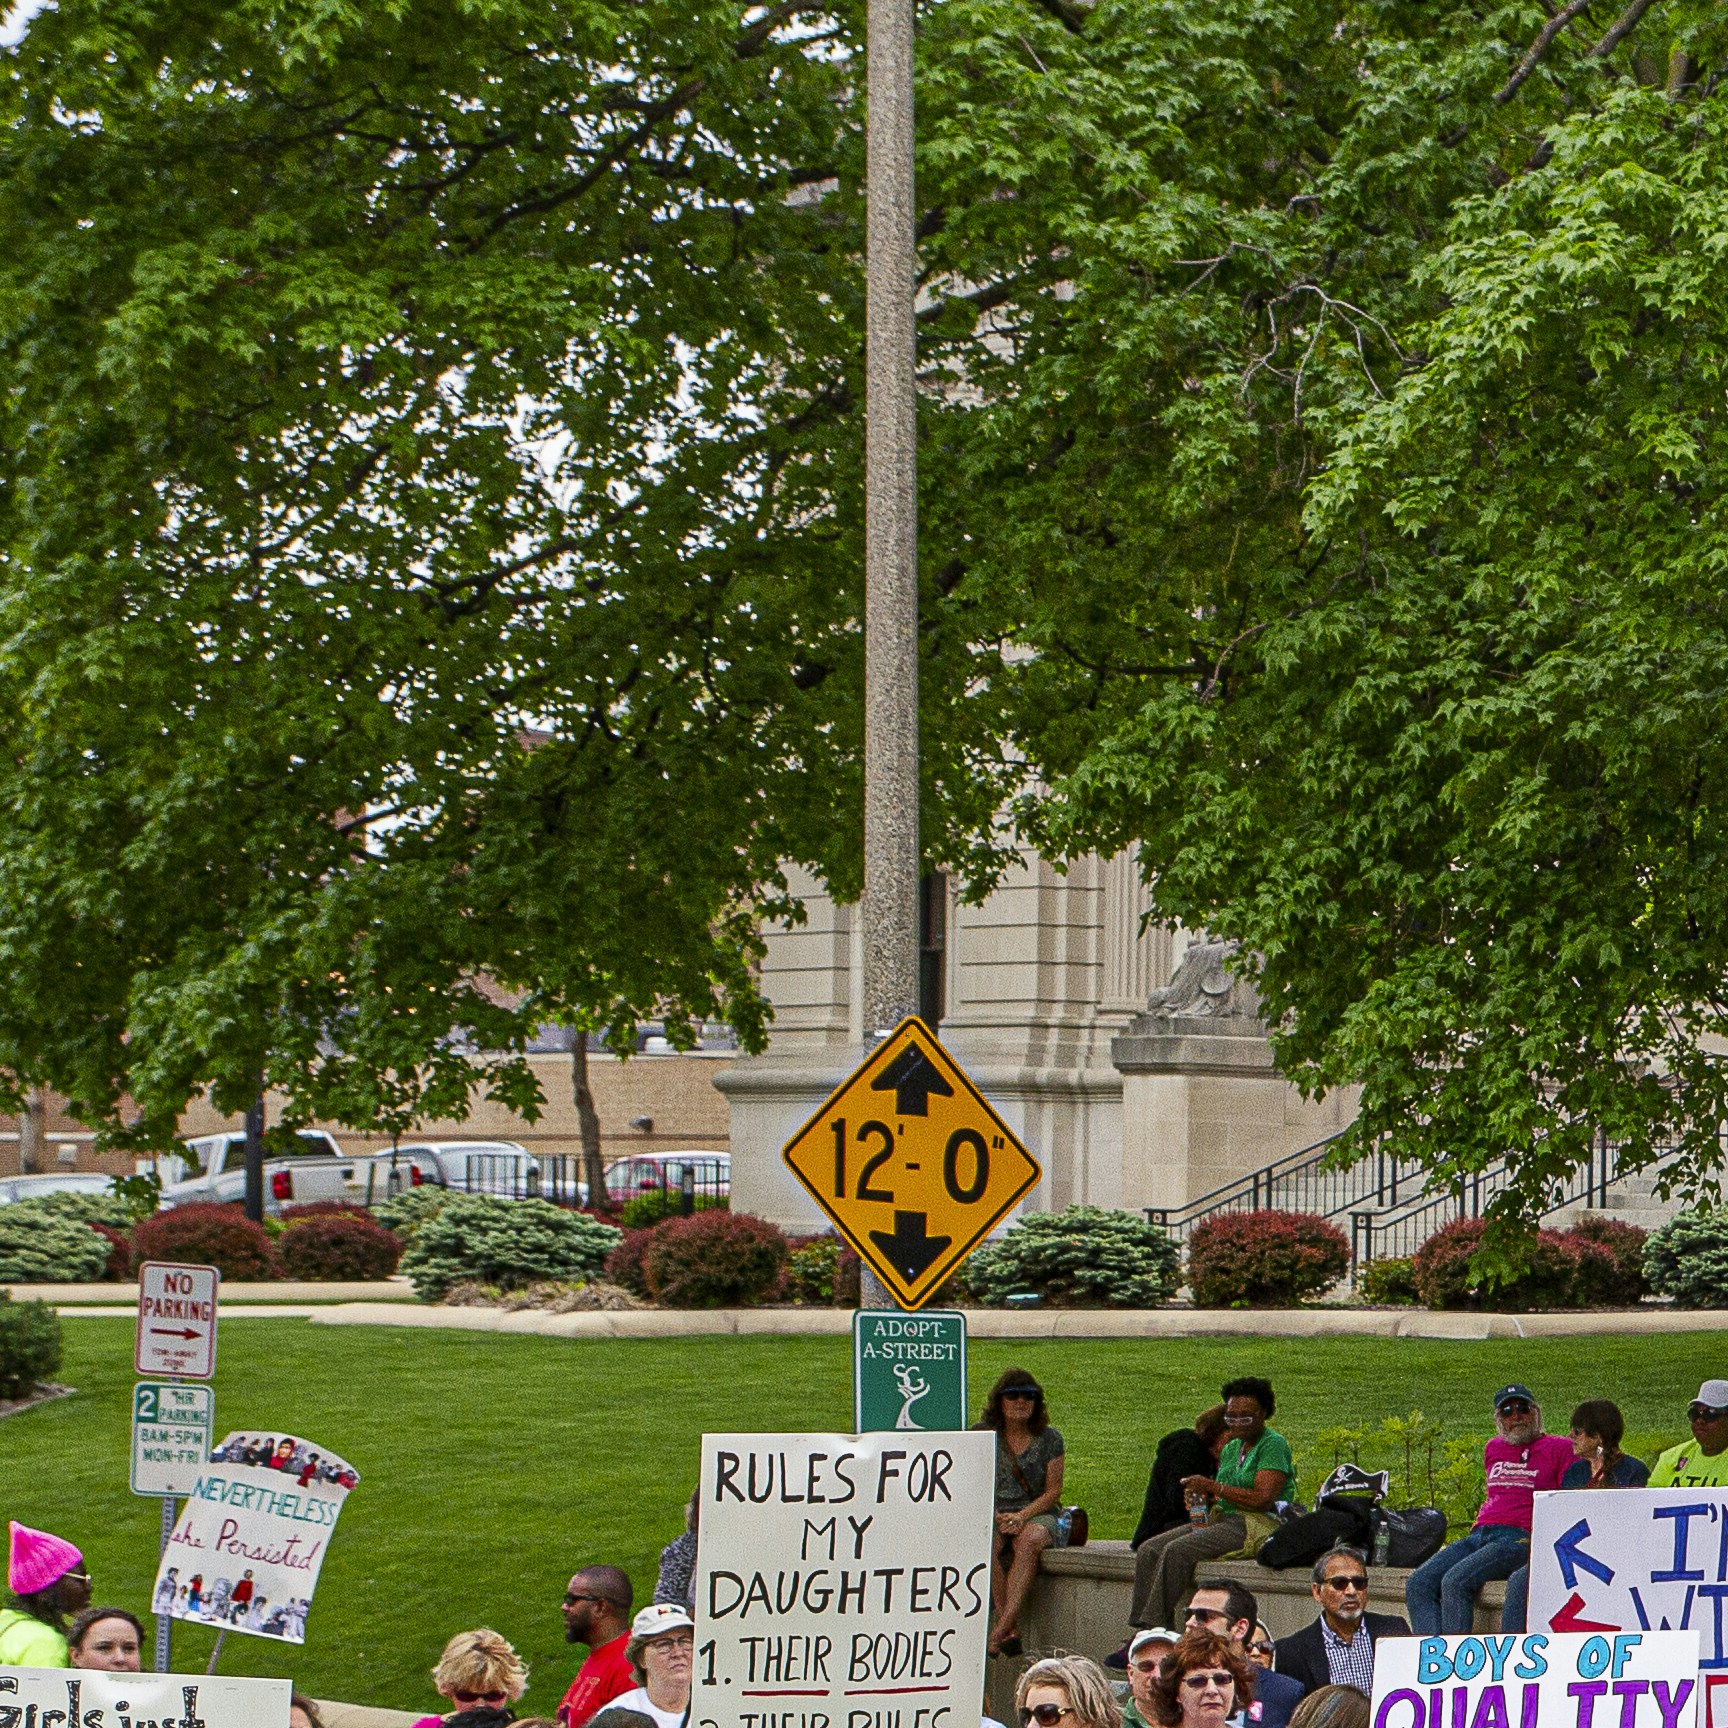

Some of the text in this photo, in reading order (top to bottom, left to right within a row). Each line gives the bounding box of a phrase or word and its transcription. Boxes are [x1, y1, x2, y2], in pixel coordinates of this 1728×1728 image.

[163, 1273, 194, 1295] NO
[143, 1297, 212, 1322] PARKING
[873, 1320, 947, 1338] ADOPT-
[863, 1342, 958, 1361] A-STREET
[138, 1390, 196, 1418] 2 HR
[159, 1407, 208, 1424] PARKING
[140, 1428, 203, 1445] 8AM-5PM
[143, 1450, 198, 1465] MON-FRI
[716, 1449, 953, 1504] RULES FOR
[191, 1476, 337, 1526] NEVERTHELESS
[215, 1518, 321, 1571] Persisted
[801, 1515, 873, 1560] MY
[709, 1562, 987, 1620] DAUGHTERS
[699, 1629, 956, 1686] 1. THEIR BODIES
[1418, 1634, 1643, 1684] BOYS OF
